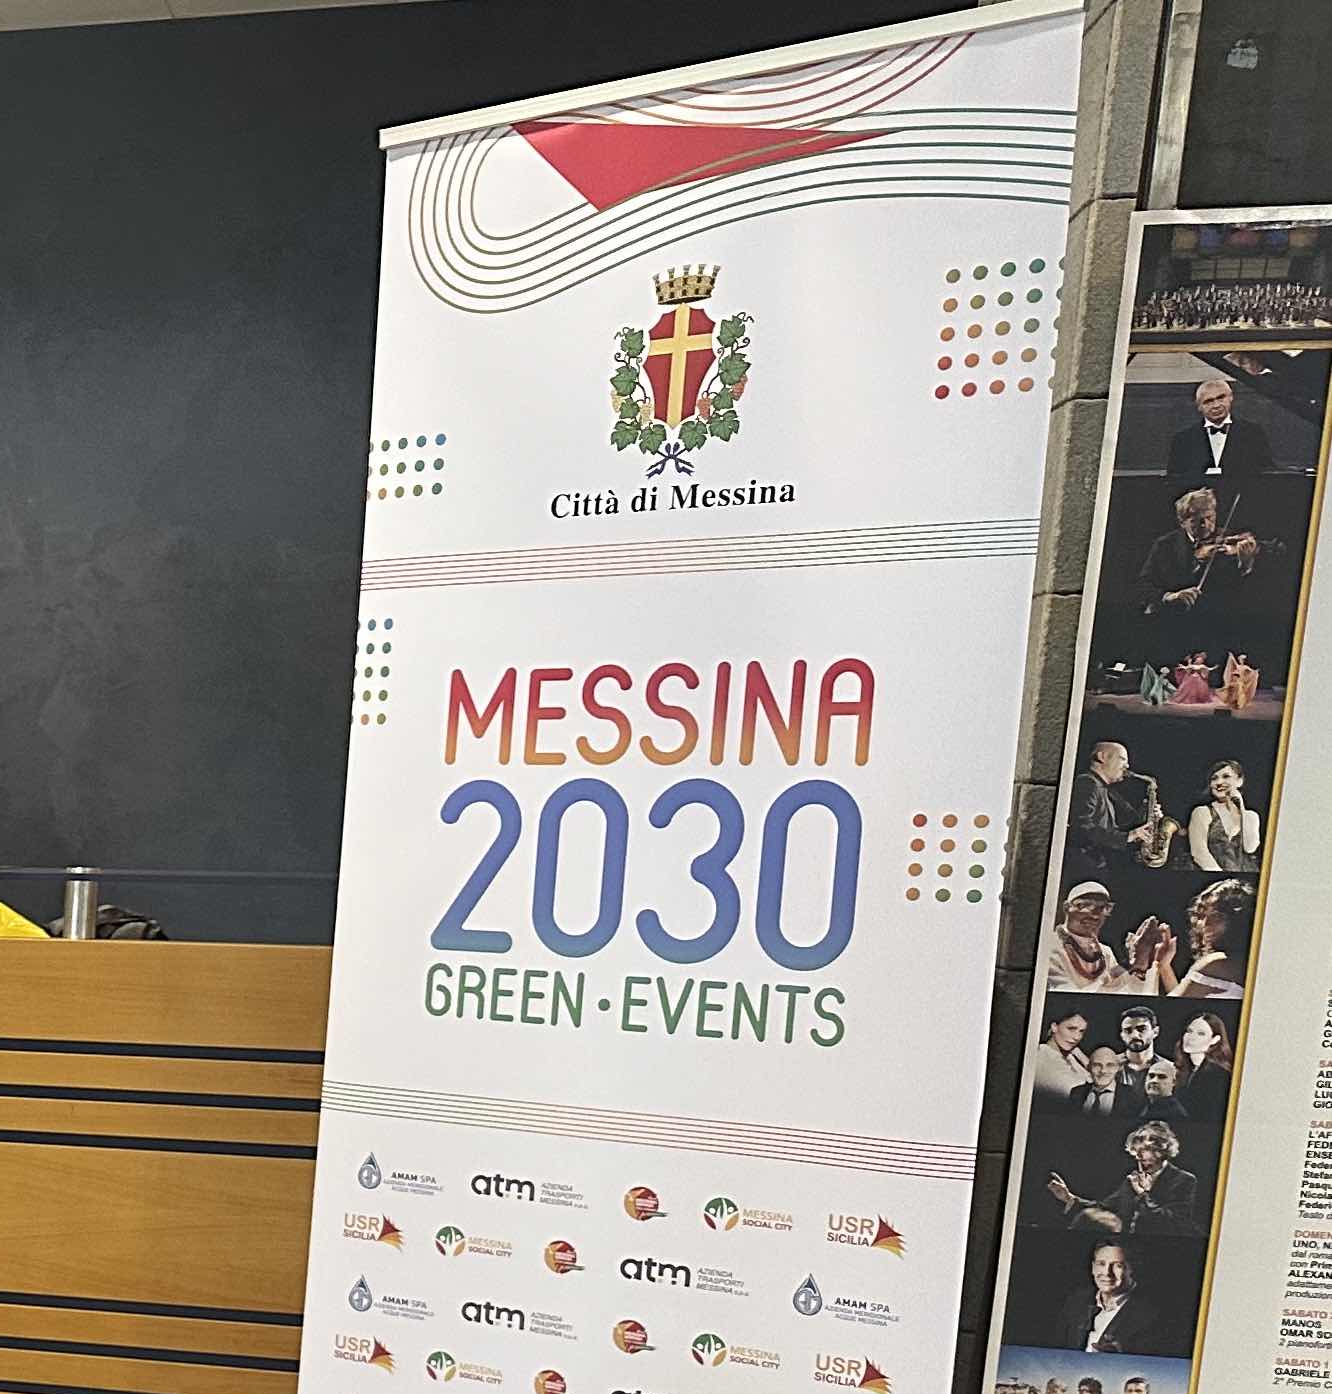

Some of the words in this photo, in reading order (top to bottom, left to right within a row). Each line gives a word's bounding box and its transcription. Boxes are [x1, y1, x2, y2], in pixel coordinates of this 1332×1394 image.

[551, 490, 620, 519] Città
[631, 486, 658, 512] di
[669, 479, 796, 510] Messina
[444, 657, 875, 766] MESSINA
[430, 777, 863, 971] 2030
[391, 1171, 417, 1182] AMAM
[471, 1174, 535, 1201] atm
[344, 1212, 380, 1231] USR
[742, 1208, 793, 1223] MESSINA
[742, 1218, 773, 1229] SOCIAL
[775, 1223, 793, 1231] CITY
[828, 1213, 875, 1236] USR
[343, 1229, 376, 1241] SICILIA
[827, 1232, 870, 1247] SICILIA
[620, 1258, 691, 1288] atm
[835, 1297, 867, 1309] AMAM
[870, 1302, 890, 1313] SPA
[461, 1301, 525, 1330] atm
[1283, 1309, 1328, 1319] SABATO
[1280, 1328, 1313, 1338] OMAR
[335, 1333, 371, 1354] USR
[333, 1349, 367, 1363] SICILIA
[730, 1345, 781, 1361] MESSINA
[729, 1355, 759, 1367] SOCIAL
[761, 1361, 781, 1370] CITY
[816, 1353, 862, 1377] USR
[1275, 1357, 1320, 1368] SABATO
[814, 1371, 857, 1388] SICILIA
[1274, 1367, 1330, 1379] GABRIELE
